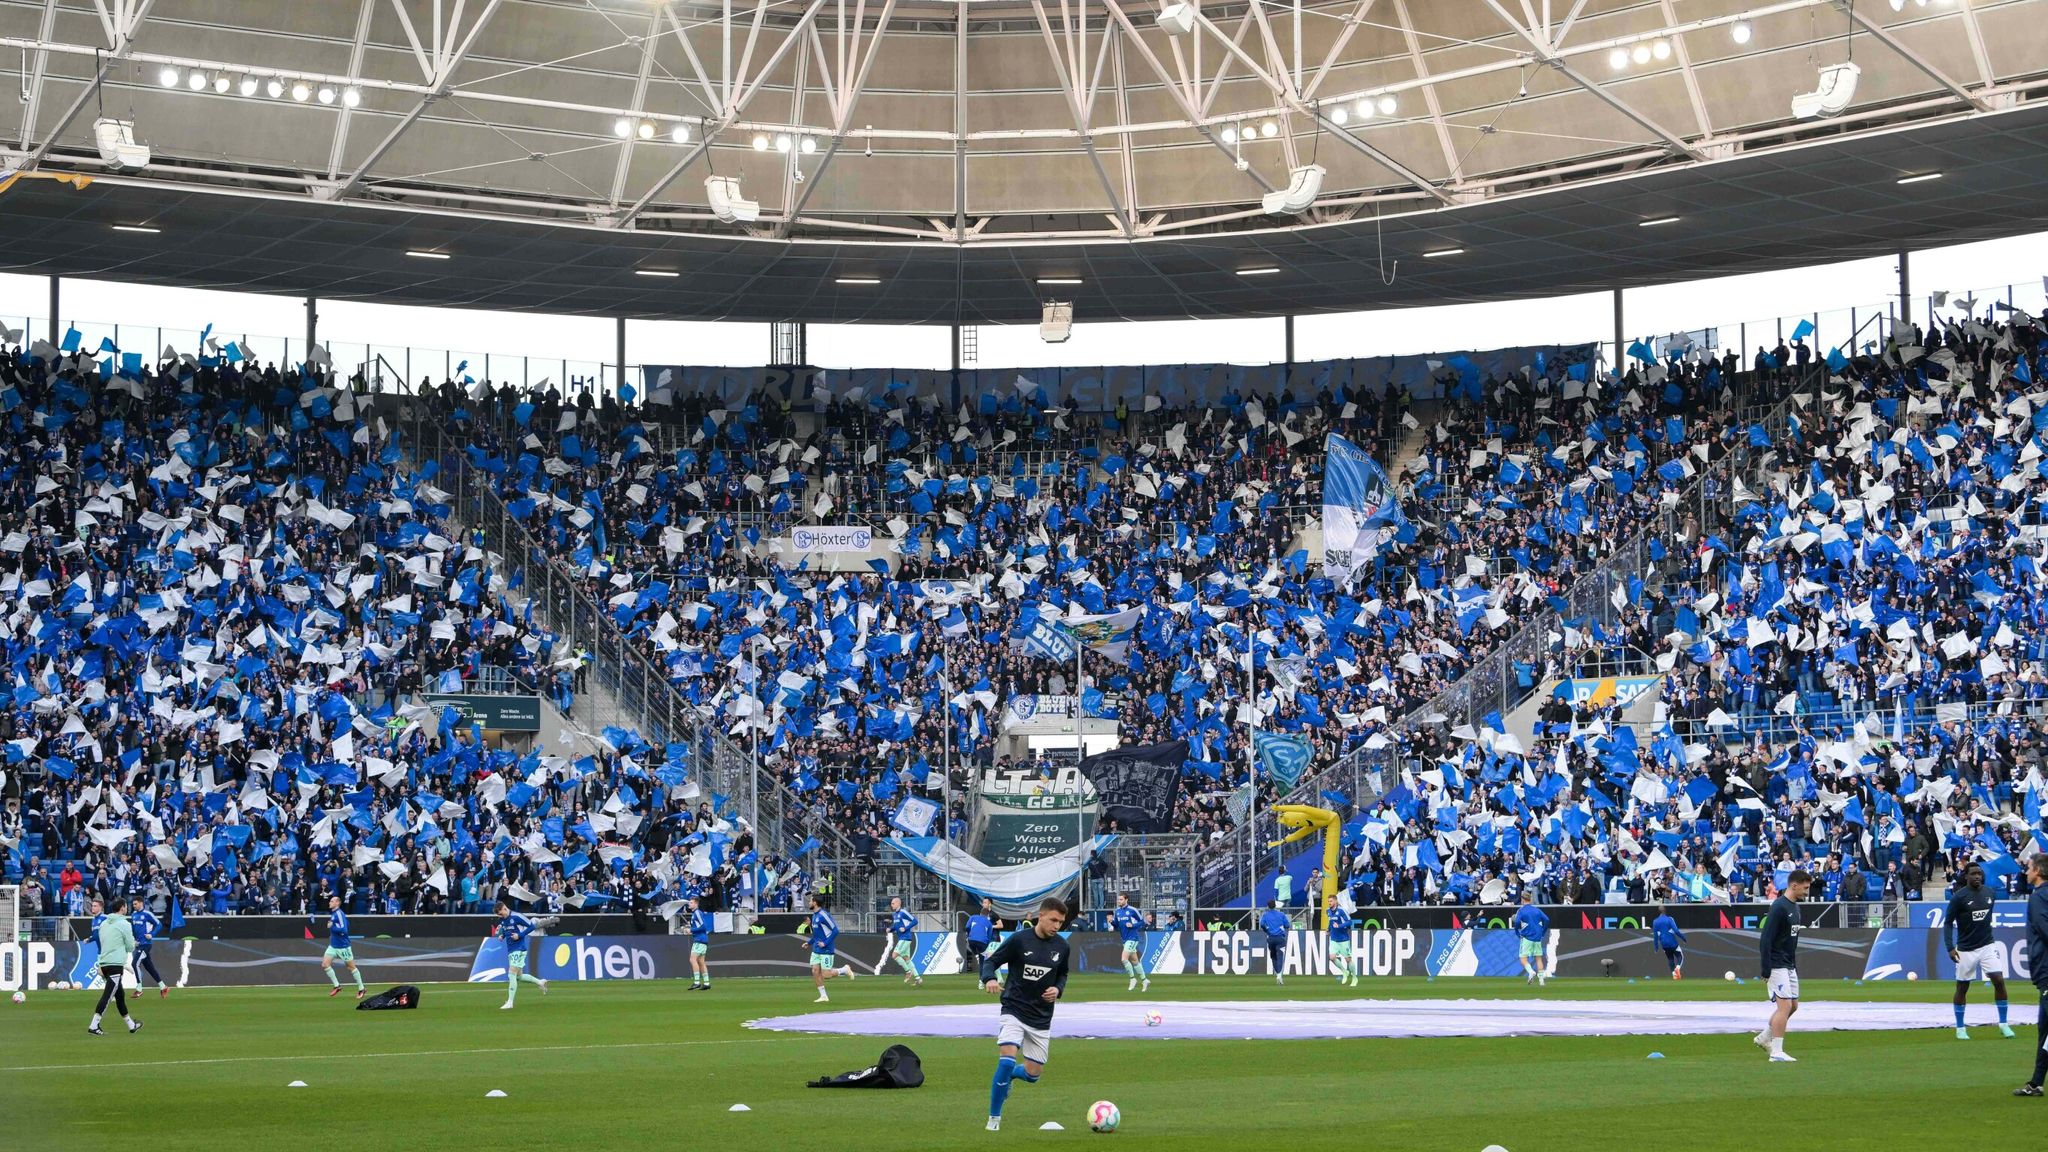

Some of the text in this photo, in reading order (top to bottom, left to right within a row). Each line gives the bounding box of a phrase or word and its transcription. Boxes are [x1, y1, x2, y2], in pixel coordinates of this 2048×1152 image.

[571, 374, 594, 394] H1
[812, 532, 851, 545] Höxter
[1040, 694, 1066, 704] BLUE
[1024, 823, 1059, 833] Zero
[1014, 834, 1066, 843] Waste.
[1018, 845, 1057, 854] Alles
[921, 933, 946, 967] TSG 1899
[1149, 932, 1171, 965] TSG 1899
[1436, 931, 1460, 967] TSG 1899
[576, 938, 656, 980] hep
[1024, 967, 1045, 979] SAP
